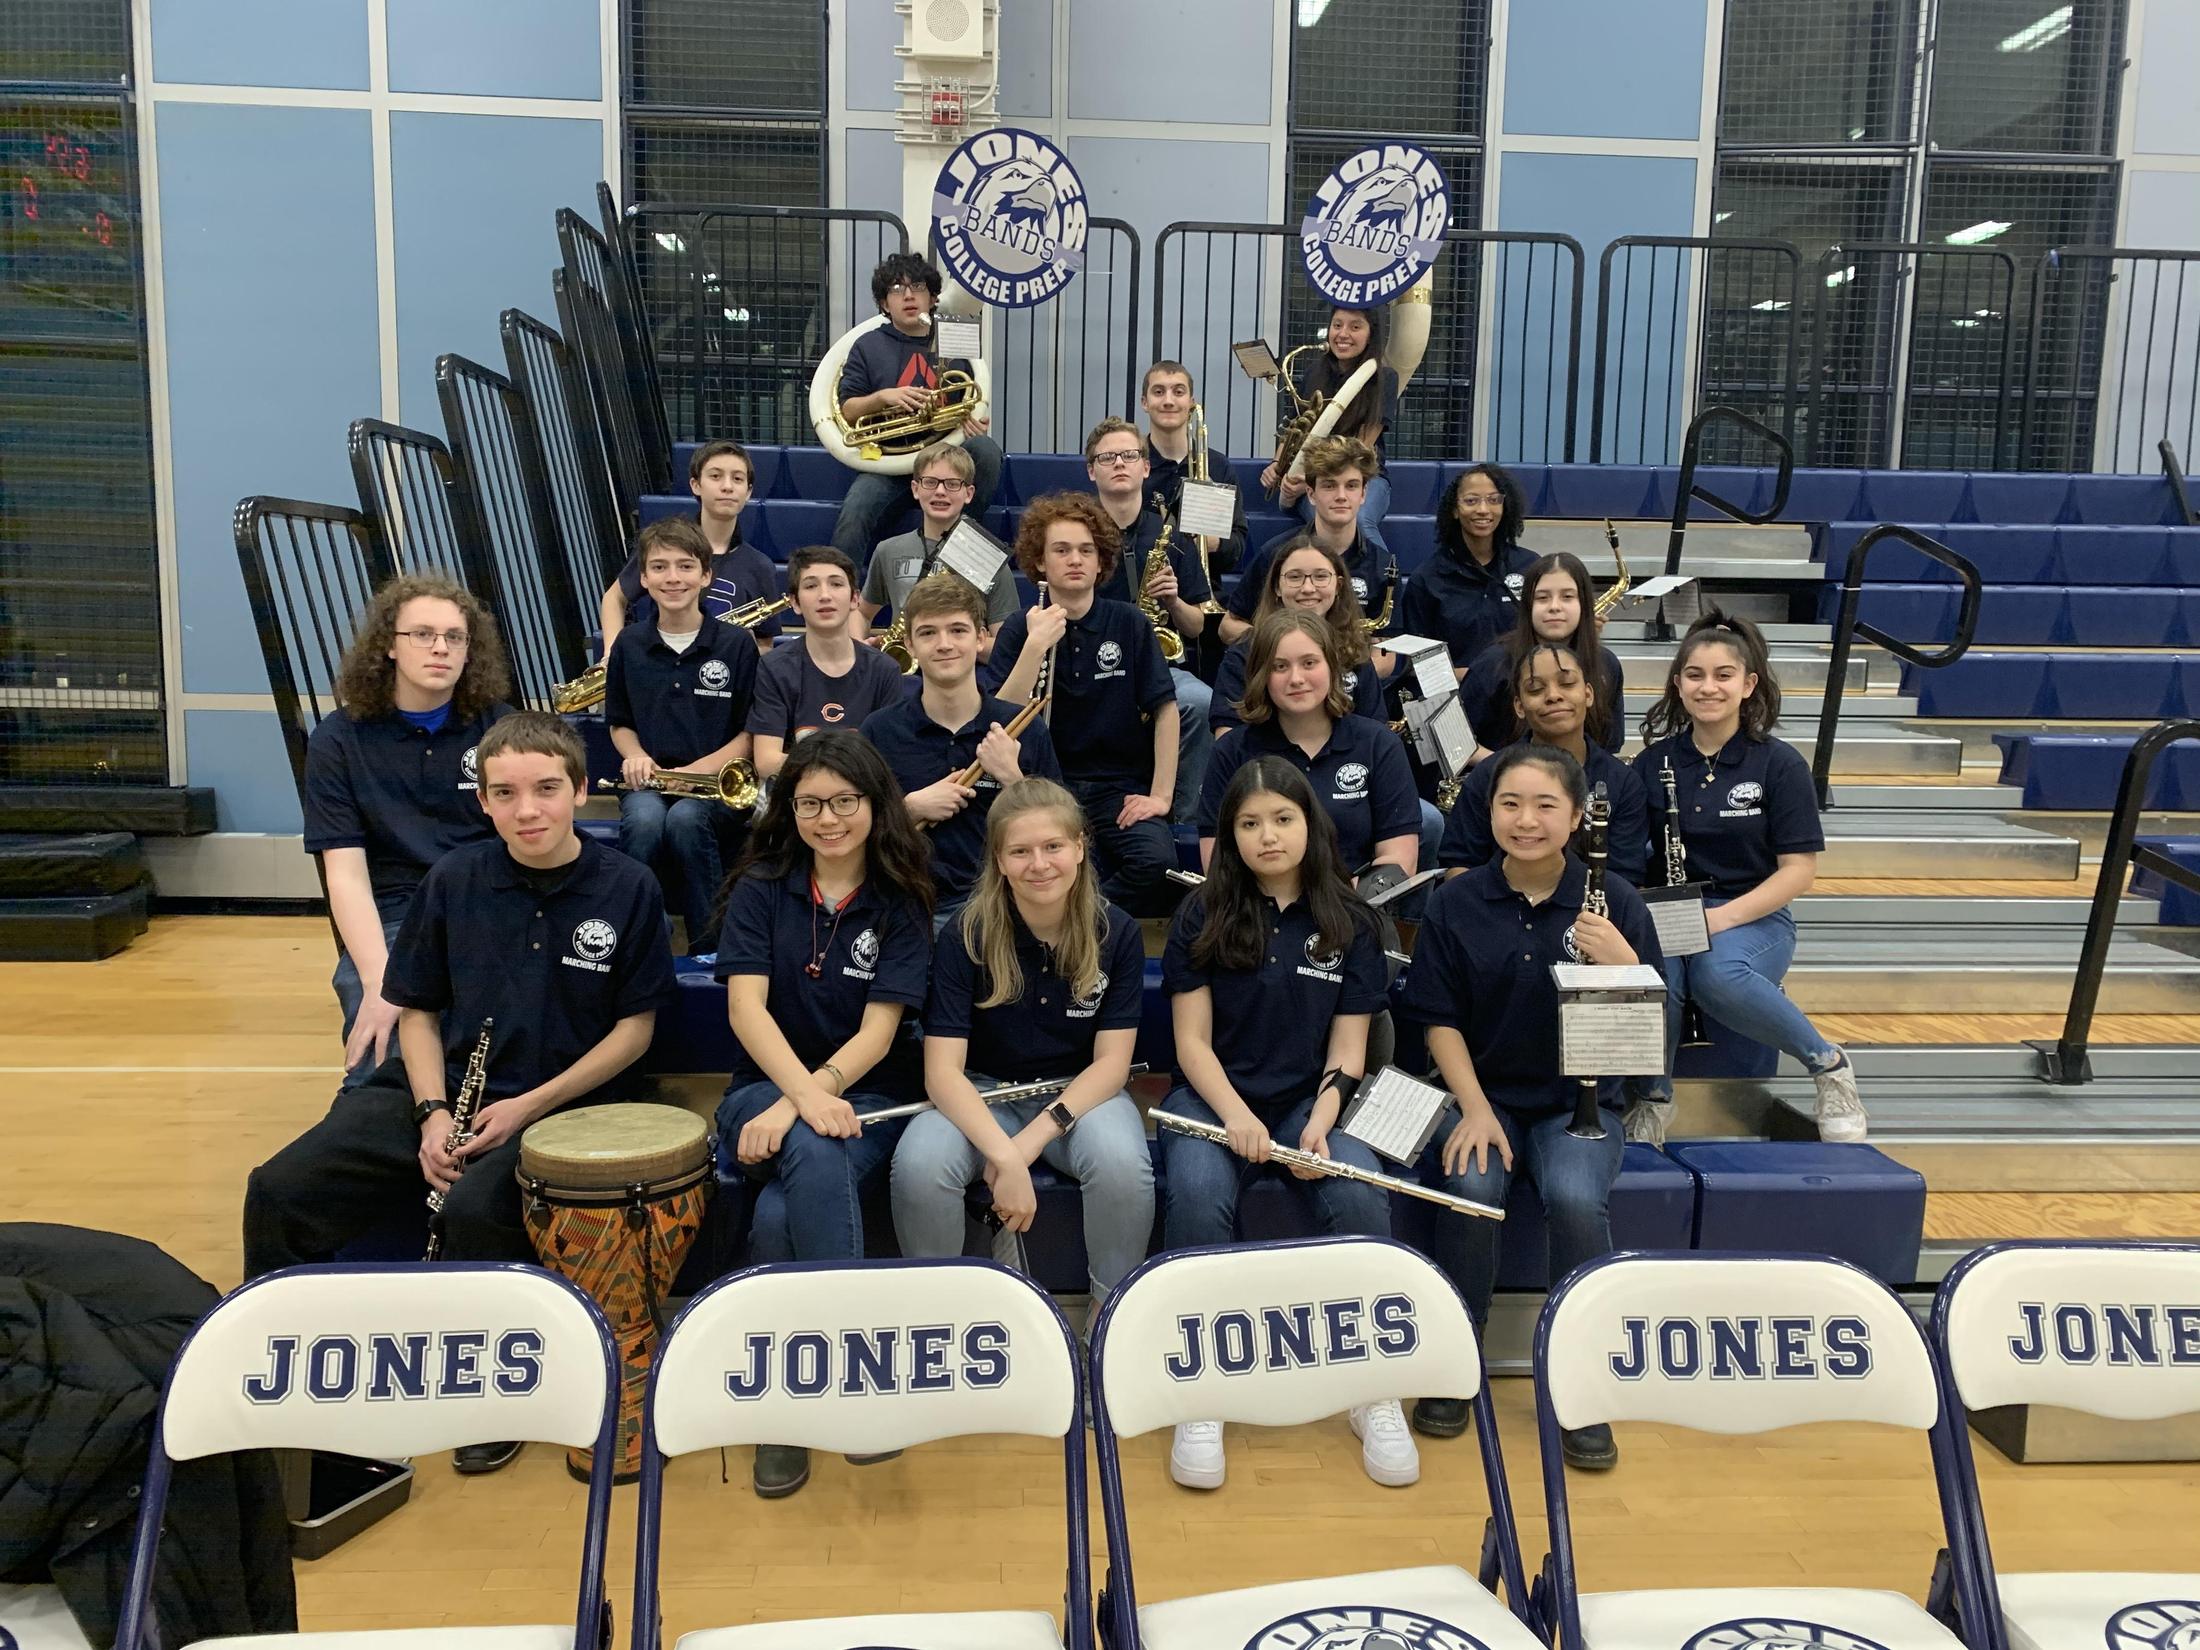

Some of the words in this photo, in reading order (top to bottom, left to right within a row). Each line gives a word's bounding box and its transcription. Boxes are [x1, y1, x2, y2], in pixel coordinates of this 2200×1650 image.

[948, 132, 1088, 252] JONES
[1315, 145, 1448, 242] JONES
[939, 215, 1010, 303] COLLEGE
[1015, 258, 1069, 304] PREP
[962, 205, 1056, 262] BANDS
[1323, 220, 1412, 258] BANDS
[1303, 231, 1363, 303] COLLEGE
[1365, 250, 1422, 302] PREP
[821, 703, 845, 722] C
[561, 955, 597, 971] MARCHING
[596, 963, 612, 973] BAN
[578, 921, 614, 945] JONES
[1296, 965, 1328, 980] MARCHING
[242, 1328, 546, 1406] JONES
[724, 1321, 1010, 1402] JONES
[1164, 1292, 1420, 1383] JONES
[1608, 1314, 1874, 1381] JONES
[2007, 1301, 2200, 1367] JONE
[1257, 1611, 1488, 1650] ONES
